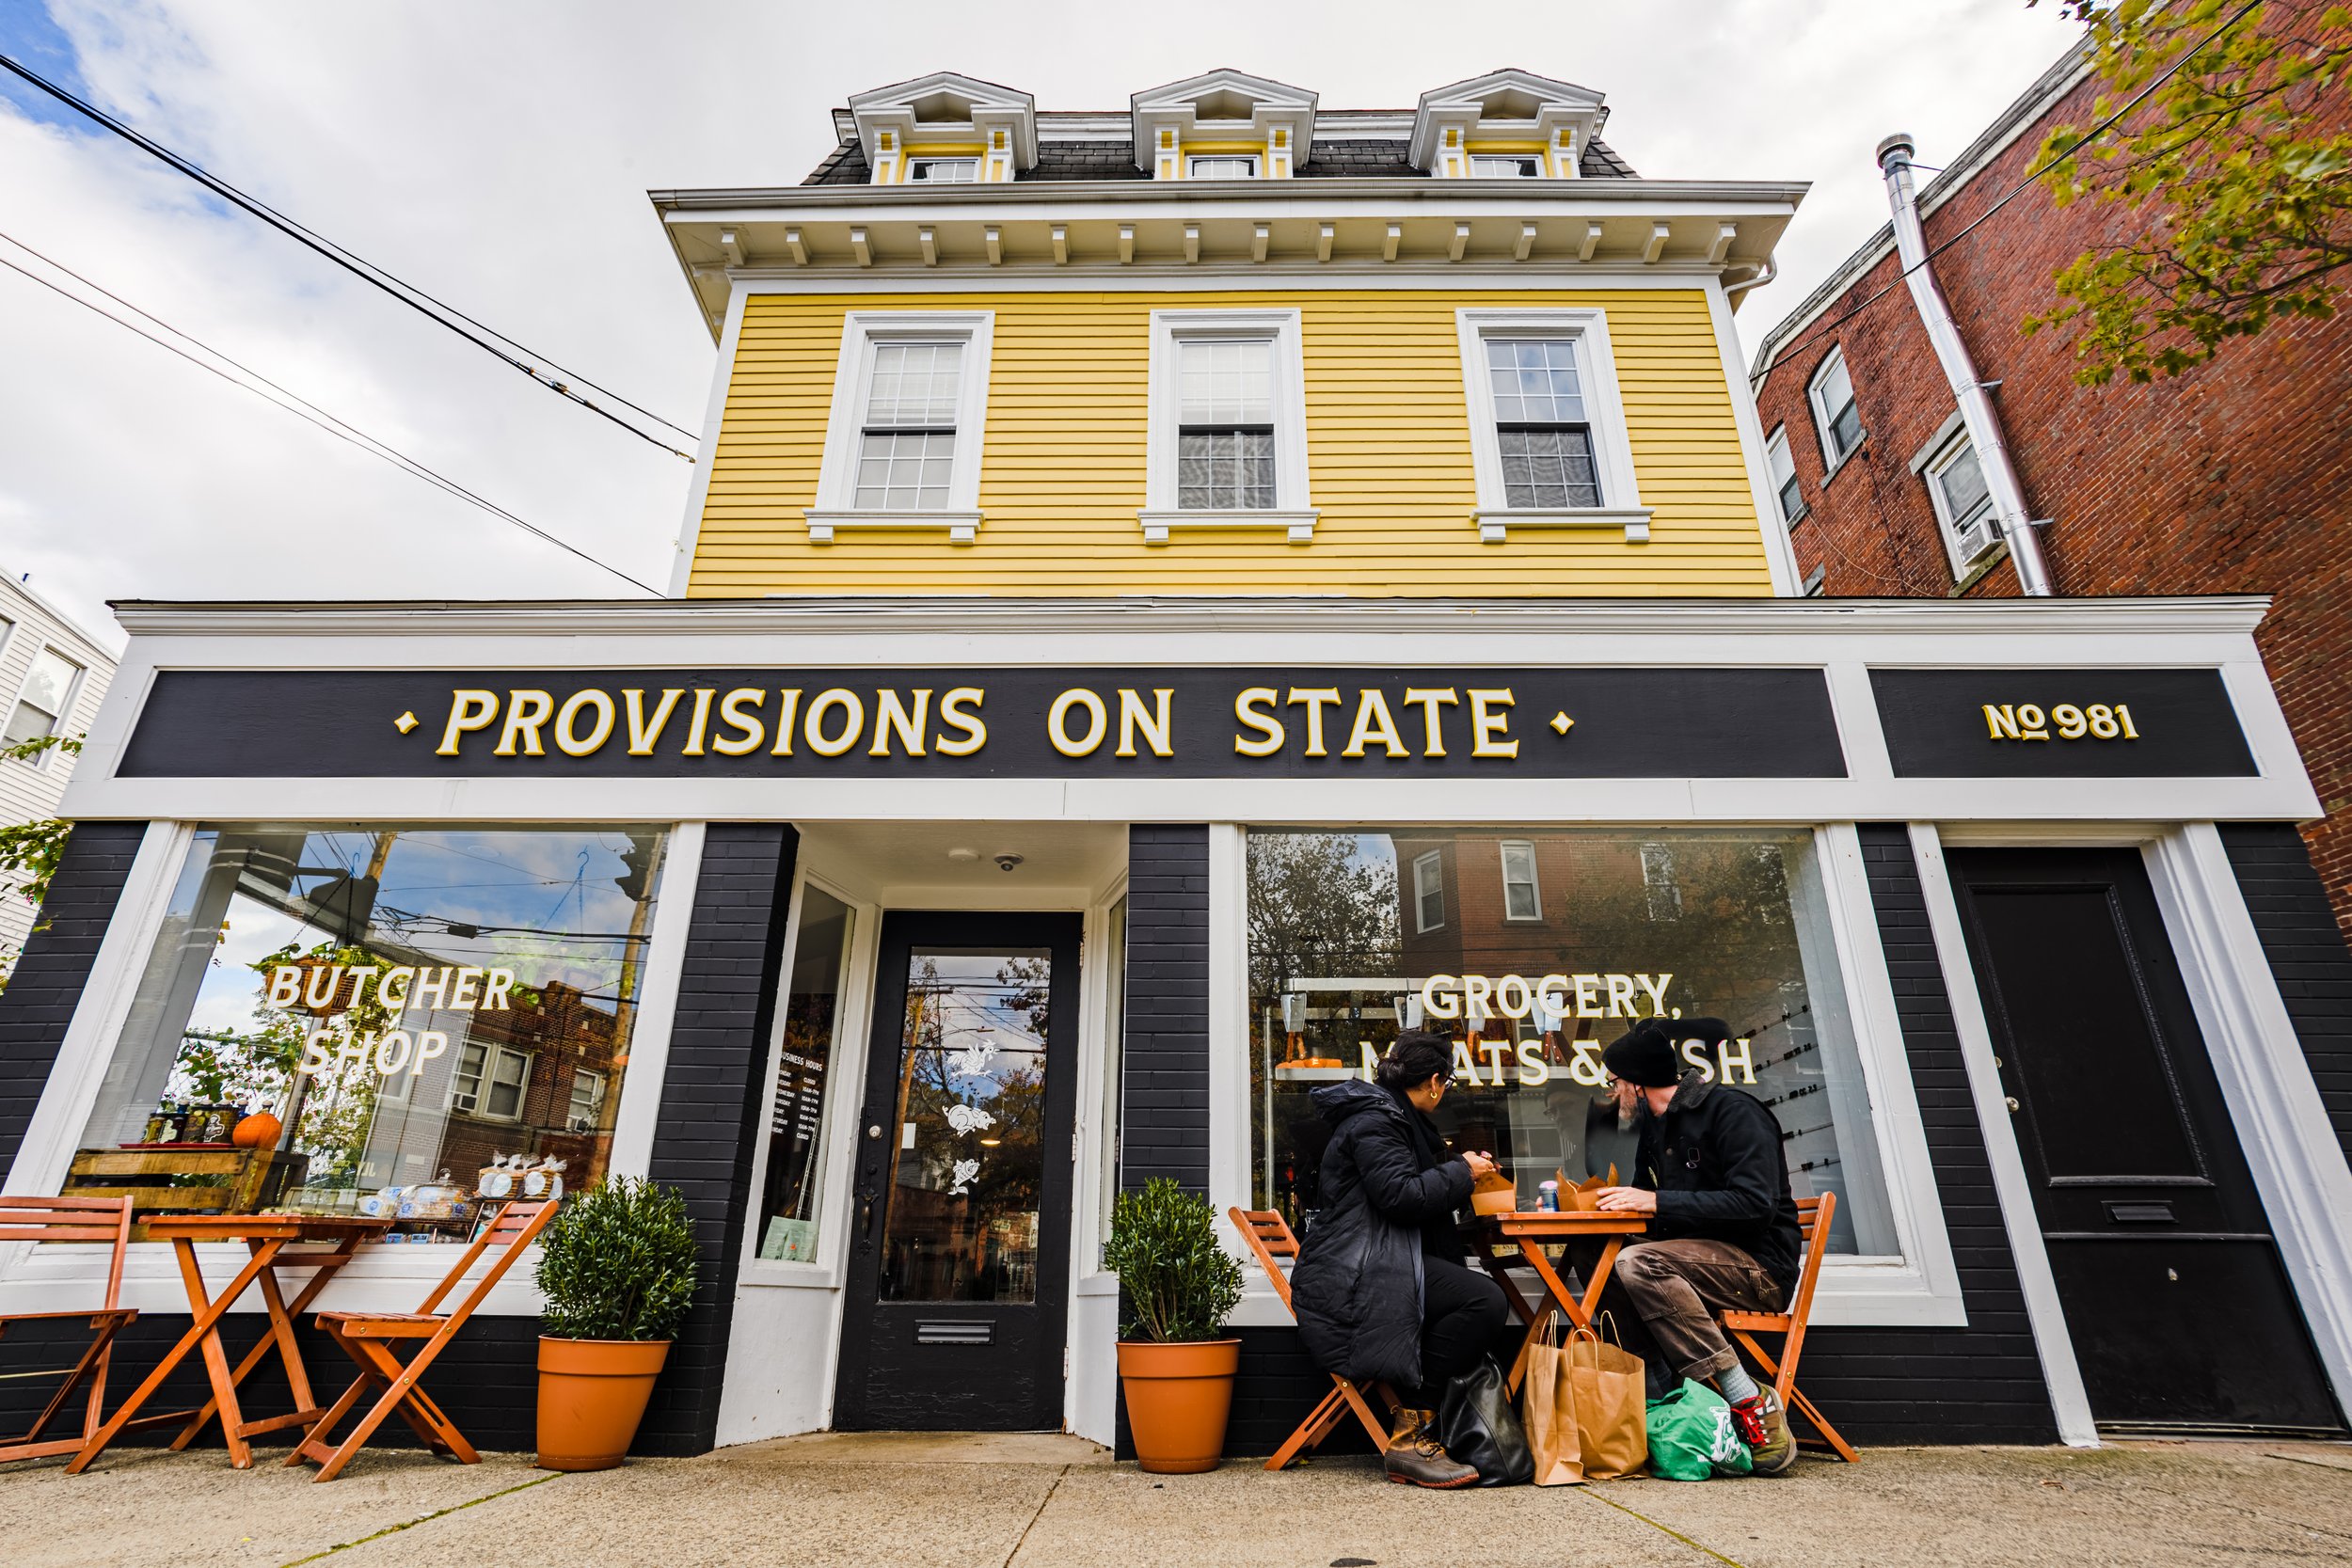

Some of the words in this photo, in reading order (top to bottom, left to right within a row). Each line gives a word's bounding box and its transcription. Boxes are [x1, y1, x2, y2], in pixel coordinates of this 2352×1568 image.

[436, 687, 987, 756] PROVISIONS
[1047, 688, 1174, 757] ON
[1234, 687, 1519, 759] STATE
[266, 965, 515, 1010] BUTCHER
[1422, 974, 1681, 1020] GROCERY,
[298, 1029, 448, 1075] SHOP
[781, 1052, 803, 1066] USINESS
[805, 1059, 822, 1071] HOURS
[1359, 1039, 1549, 1086] MATS
[1569, 1038, 1611, 1088] &
[1669, 1038, 1757, 1085] SH
